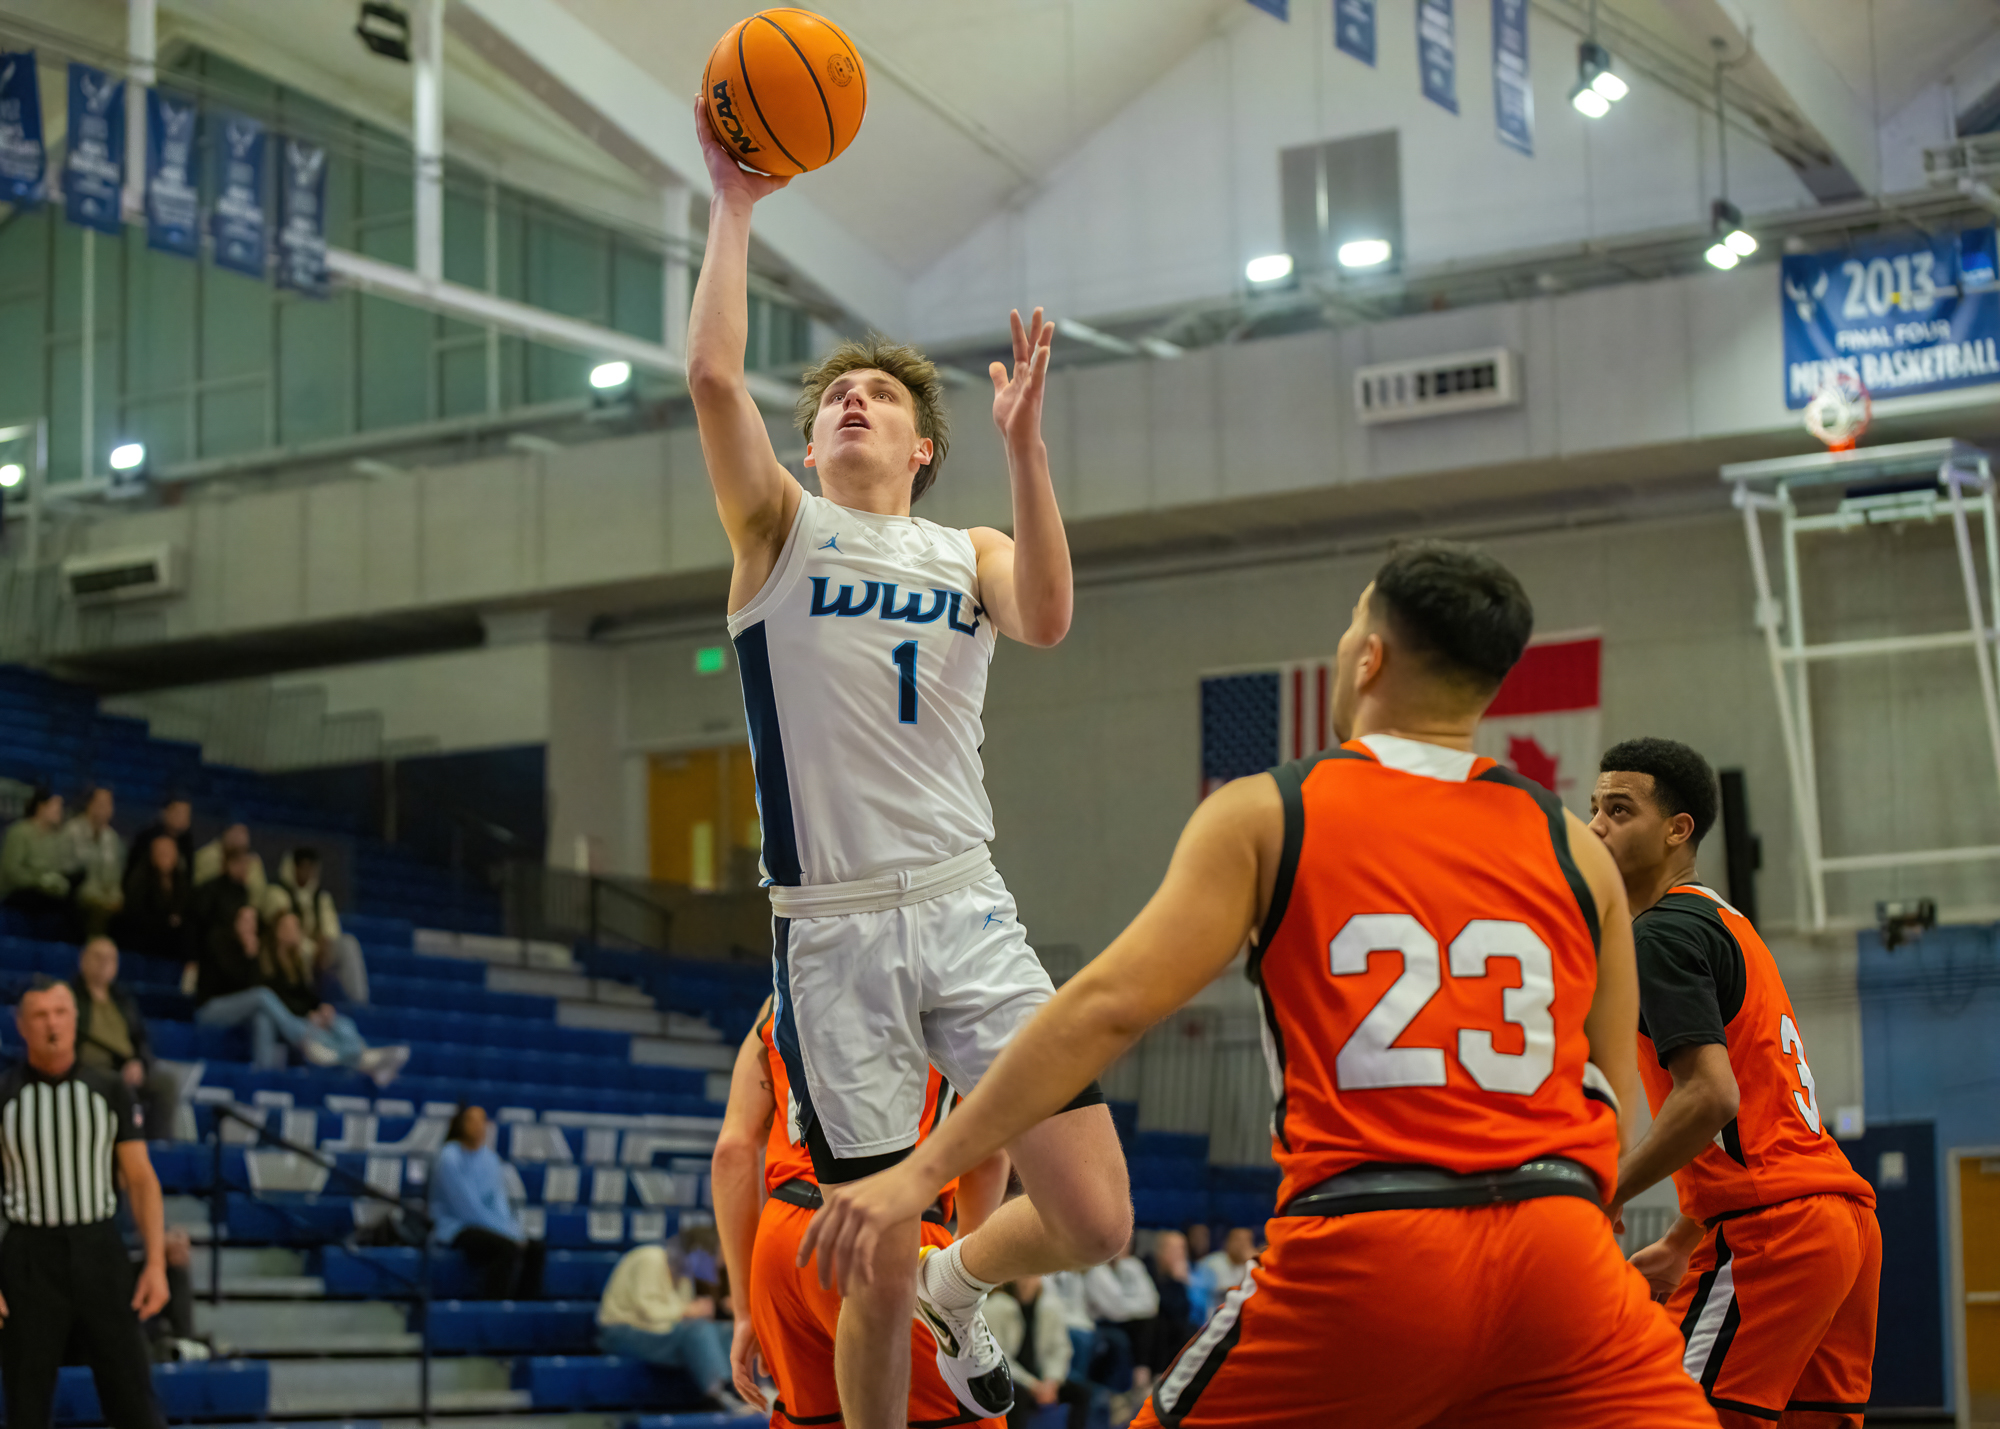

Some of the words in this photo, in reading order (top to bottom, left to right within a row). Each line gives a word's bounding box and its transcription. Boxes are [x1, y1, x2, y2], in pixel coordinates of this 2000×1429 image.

[713, 80, 761, 154] NCAA
[1842, 251, 1937, 319] 2013
[1835, 327, 1894, 351] FINAL
[1894, 318, 1951, 345] FOUR
[1860, 337, 2000, 390] BASKETBALL
[892, 639, 918, 725] 1
[1329, 913, 1556, 1097] 23
[1780, 1013, 1821, 1136] 3
